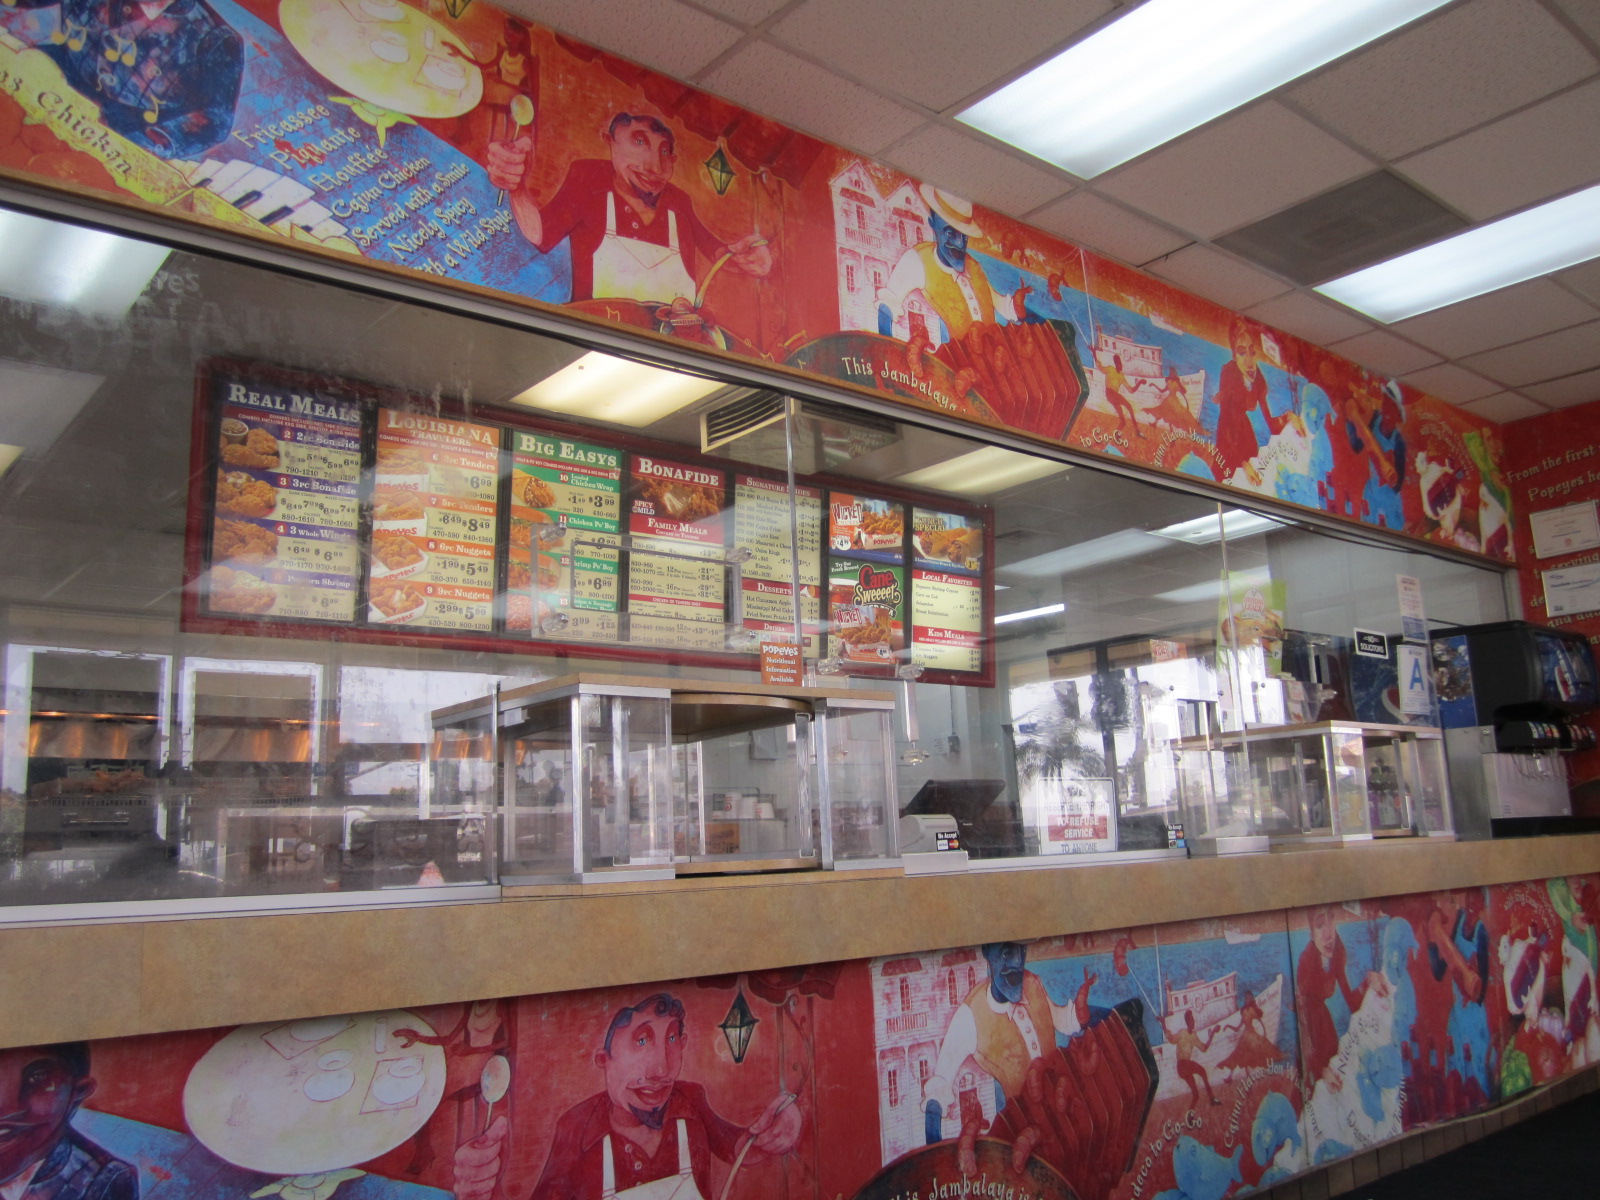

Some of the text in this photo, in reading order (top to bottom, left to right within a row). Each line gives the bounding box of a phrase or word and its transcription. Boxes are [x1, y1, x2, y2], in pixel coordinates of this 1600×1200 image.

[232, 104, 330, 148] Fricassee
[38, 91, 131, 182] Chicken
[269, 126, 361, 171] Piquante
[332, 156, 431, 218] Cajun Chicken
[351, 162, 470, 247] Served with a Smile
[387, 197, 477, 261] Nicely Spicy
[479, 209, 513, 235] Style
[446, 225, 488, 259] Wild
[444, 254, 459, 268] a
[842, 356, 873, 376] This
[227, 383, 361, 422] REAL MEALS
[284, 430, 292, 439] 2
[387, 409, 494, 446] LOUISIANA
[1080, 426, 1129, 448] to Go-Go
[520, 434, 617, 467] BIG EASYS
[432, 453, 496, 471] 6 Tenders
[1507, 444, 1596, 484] From the first
[560, 473, 569, 481] 10
[638, 457, 719, 486] BONAFIDE
[280, 477, 287, 486] 3
[570, 479, 614, 492] Chicken Wrap
[746, 477, 785, 493] SIGNATURE
[1528, 474, 1584, 502] Popeyes
[431, 497, 437, 505] 7
[634, 500, 653, 508] SPICY
[637, 506, 655, 515] MILD
[832, 503, 864, 524] WICKED
[277, 525, 285, 534] 4
[290, 526, 297, 535] 3
[569, 517, 593, 527] Chicken
[604, 522, 616, 531] Boy
[647, 517, 708, 535] FAMILY MEALS
[429, 541, 435, 550] 8
[456, 545, 492, 557] Nuggets
[560, 557, 569, 565] 12
[573, 560, 592, 569] hrimp
[860, 567, 895, 590] Cane
[922, 571, 973, 587] LOCAL FAVORITES
[427, 586, 433, 595] 9
[454, 589, 490, 600] Nuggets
[757, 583, 792, 595] DESSERTS
[560, 598, 569, 606] 13
[927, 628, 965, 639] KIDS MEALS
[766, 657, 796, 665] Nutritional
[765, 666, 797, 674] Information
[1409, 658, 1424, 690] A
[769, 675, 794, 683] Available
[1056, 816, 1100, 827] TO REFUSE
[1064, 828, 1094, 839] SERVICE
[1061, 843, 1098, 853] TO ANYONE
[1150, 1140, 1163, 1157] to
[1163, 1109, 1203, 1141] Go-Go
[928, 1172, 1014, 1200] Jambalaya
